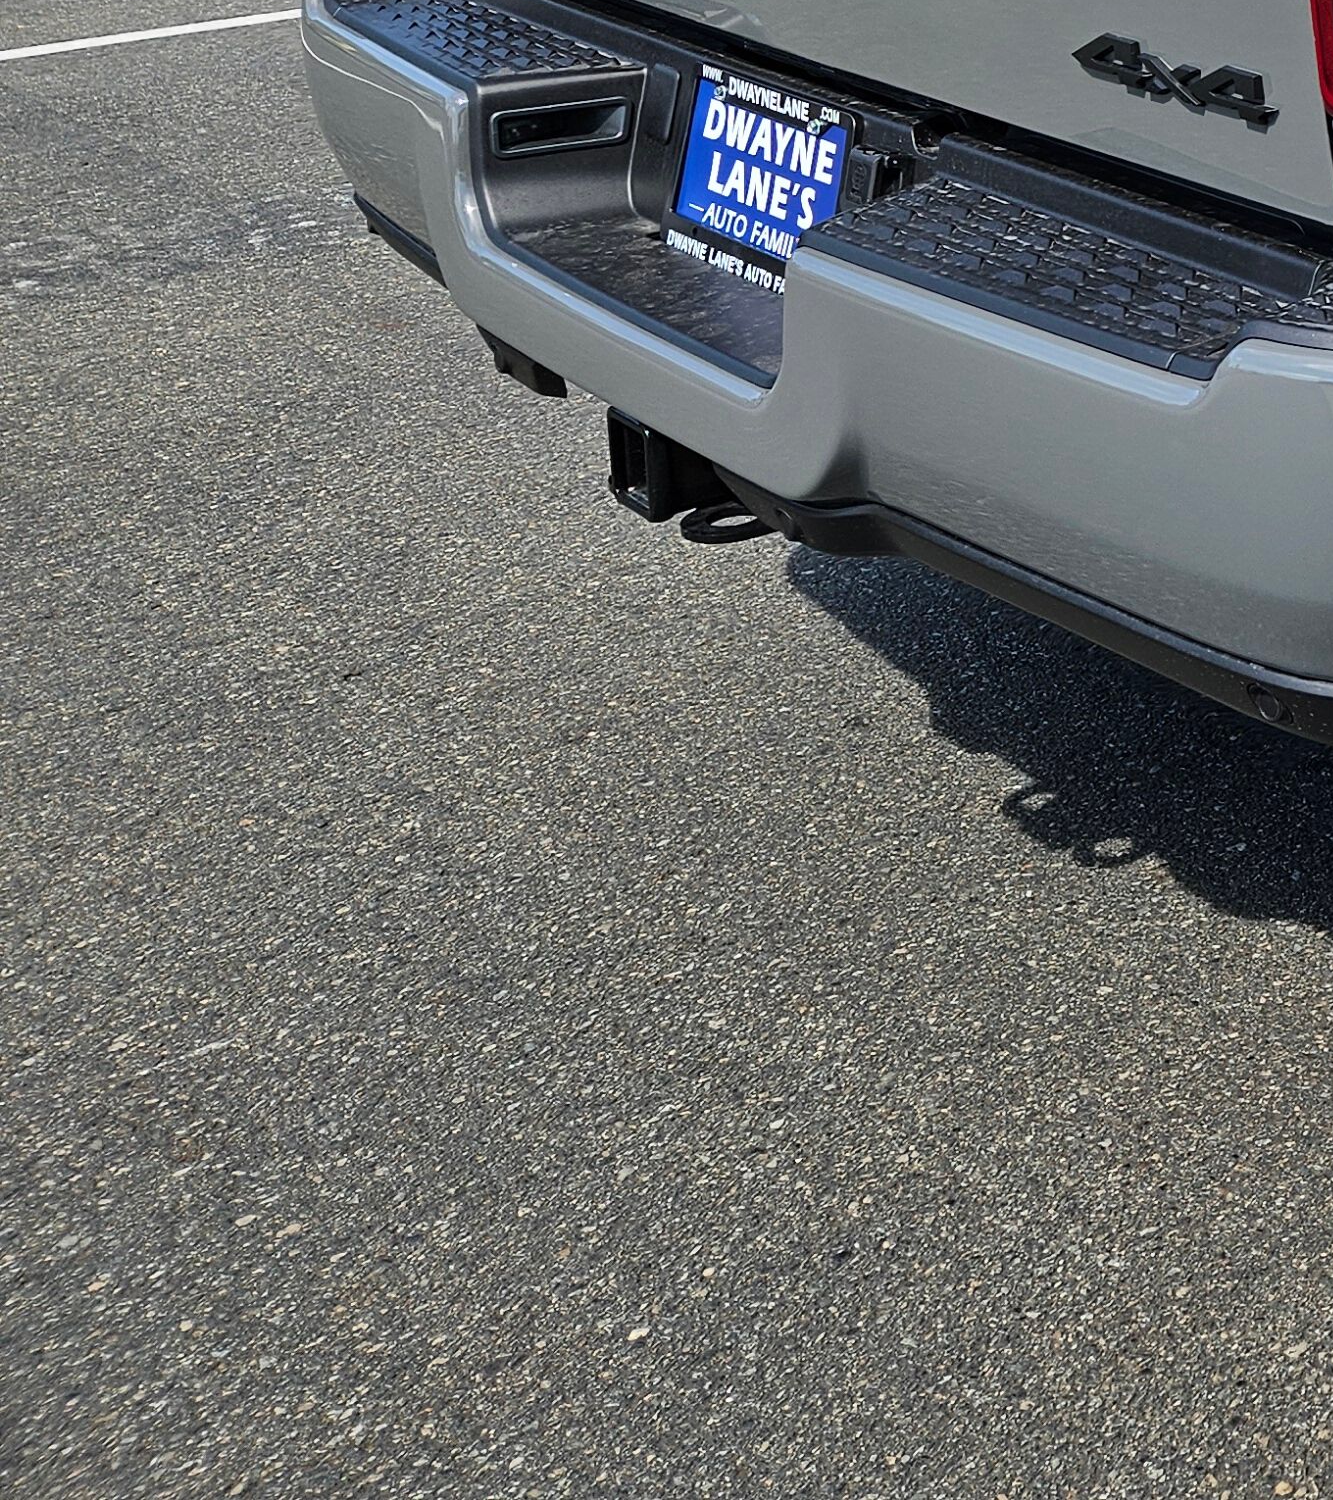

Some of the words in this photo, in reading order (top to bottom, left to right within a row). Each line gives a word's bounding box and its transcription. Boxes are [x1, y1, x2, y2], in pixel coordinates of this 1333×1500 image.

[728, 76, 810, 122] DWAYNELANE
[702, 99, 838, 185] DWAYNE
[702, 203, 748, 238] AUTO
[707, 151, 816, 230] LANE'S
[666, 229, 708, 261] DWAYNE
[708, 247, 743, 275] LANE'S
[743, 263, 772, 289] AUTO
